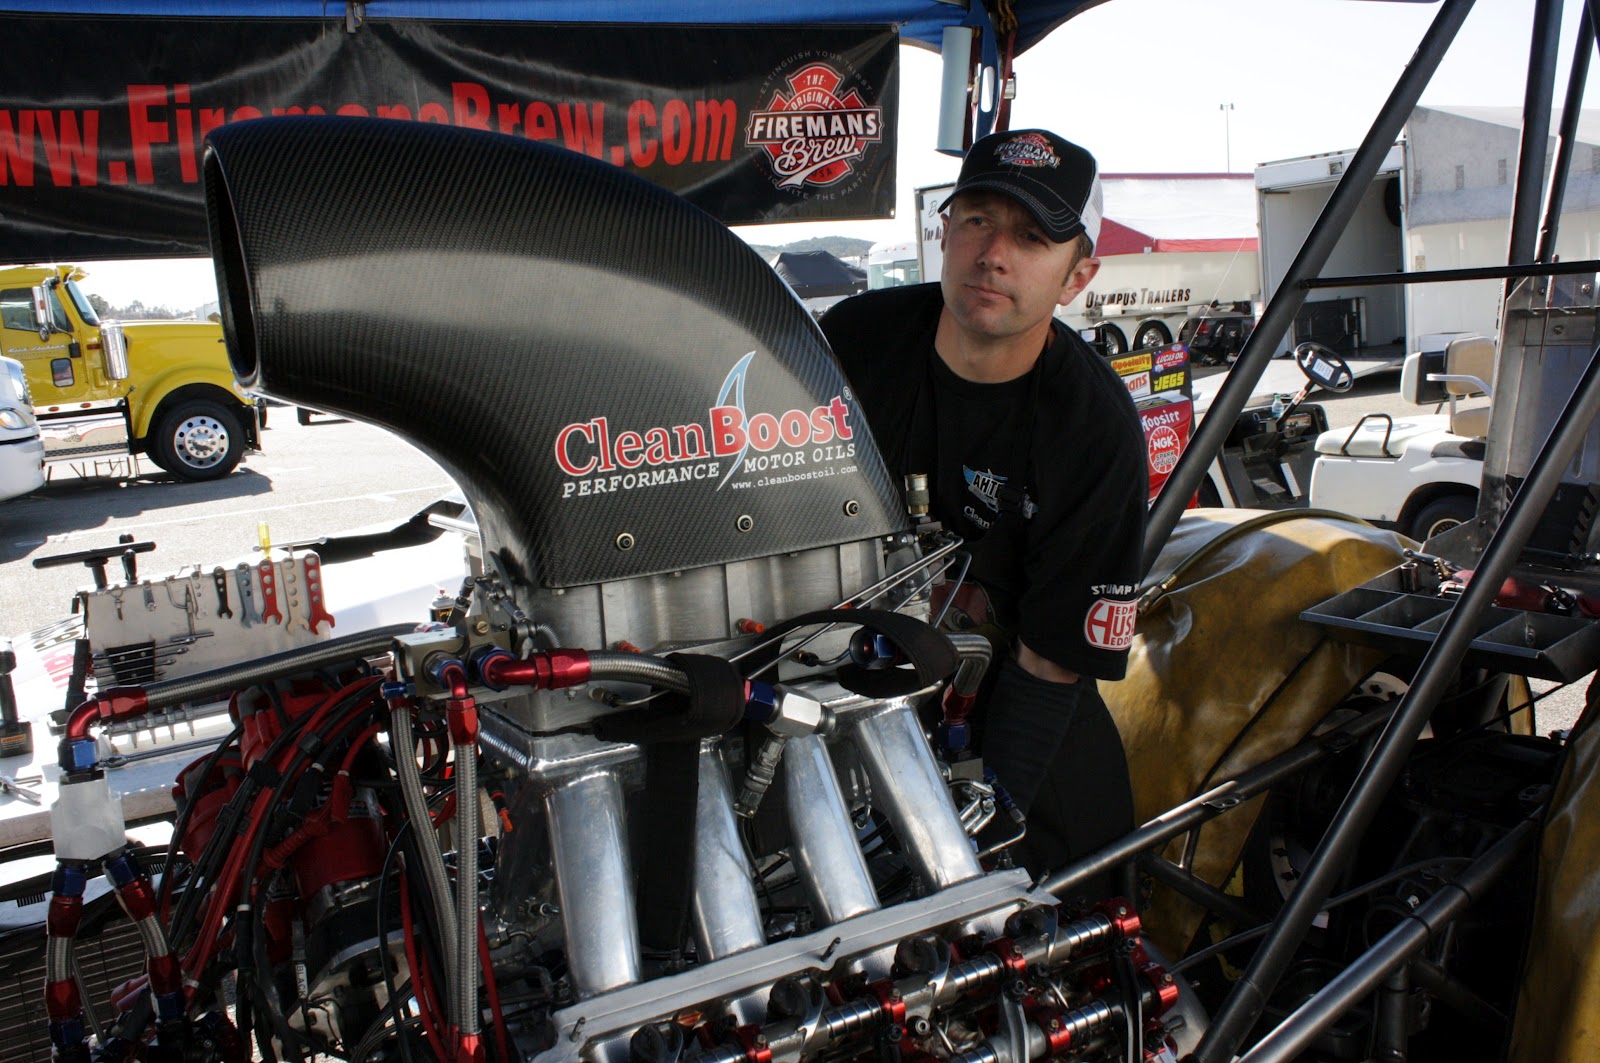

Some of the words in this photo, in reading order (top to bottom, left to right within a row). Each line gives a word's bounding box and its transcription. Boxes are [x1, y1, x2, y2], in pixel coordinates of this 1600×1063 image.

[760, 50, 811, 95] EXTINGUISH
[815, 50, 843, 62] YOUR
[844, 60, 873, 92] THIRST
[806, 74, 825, 86] THE
[790, 90, 835, 111] ORIGINAL
[752, 113, 878, 140] FIREMANS
[774, 135, 858, 178] Brew
[816, 193, 836, 201] THE
[840, 171, 868, 197] PARTY
[1085, 290, 1138, 309] OLYMPUS
[1140, 288, 1191, 305] TRAILERS
[1156, 353, 1175, 365] LUCAS
[1175, 351, 1185, 360] OIL
[1153, 371, 1185, 392] JEGS
[1153, 434, 1174, 451] NGK
[1155, 450, 1175, 461] SPARK
[1155, 457, 1177, 468] PLUGS
[561, 462, 721, 499] PERFORMANCE
[743, 451, 806, 474] MOTOR
[812, 443, 857, 463] OILS
[731, 464, 859, 490] www.cleanboostoil.com
[296, 965, 306, 998] BLACK
